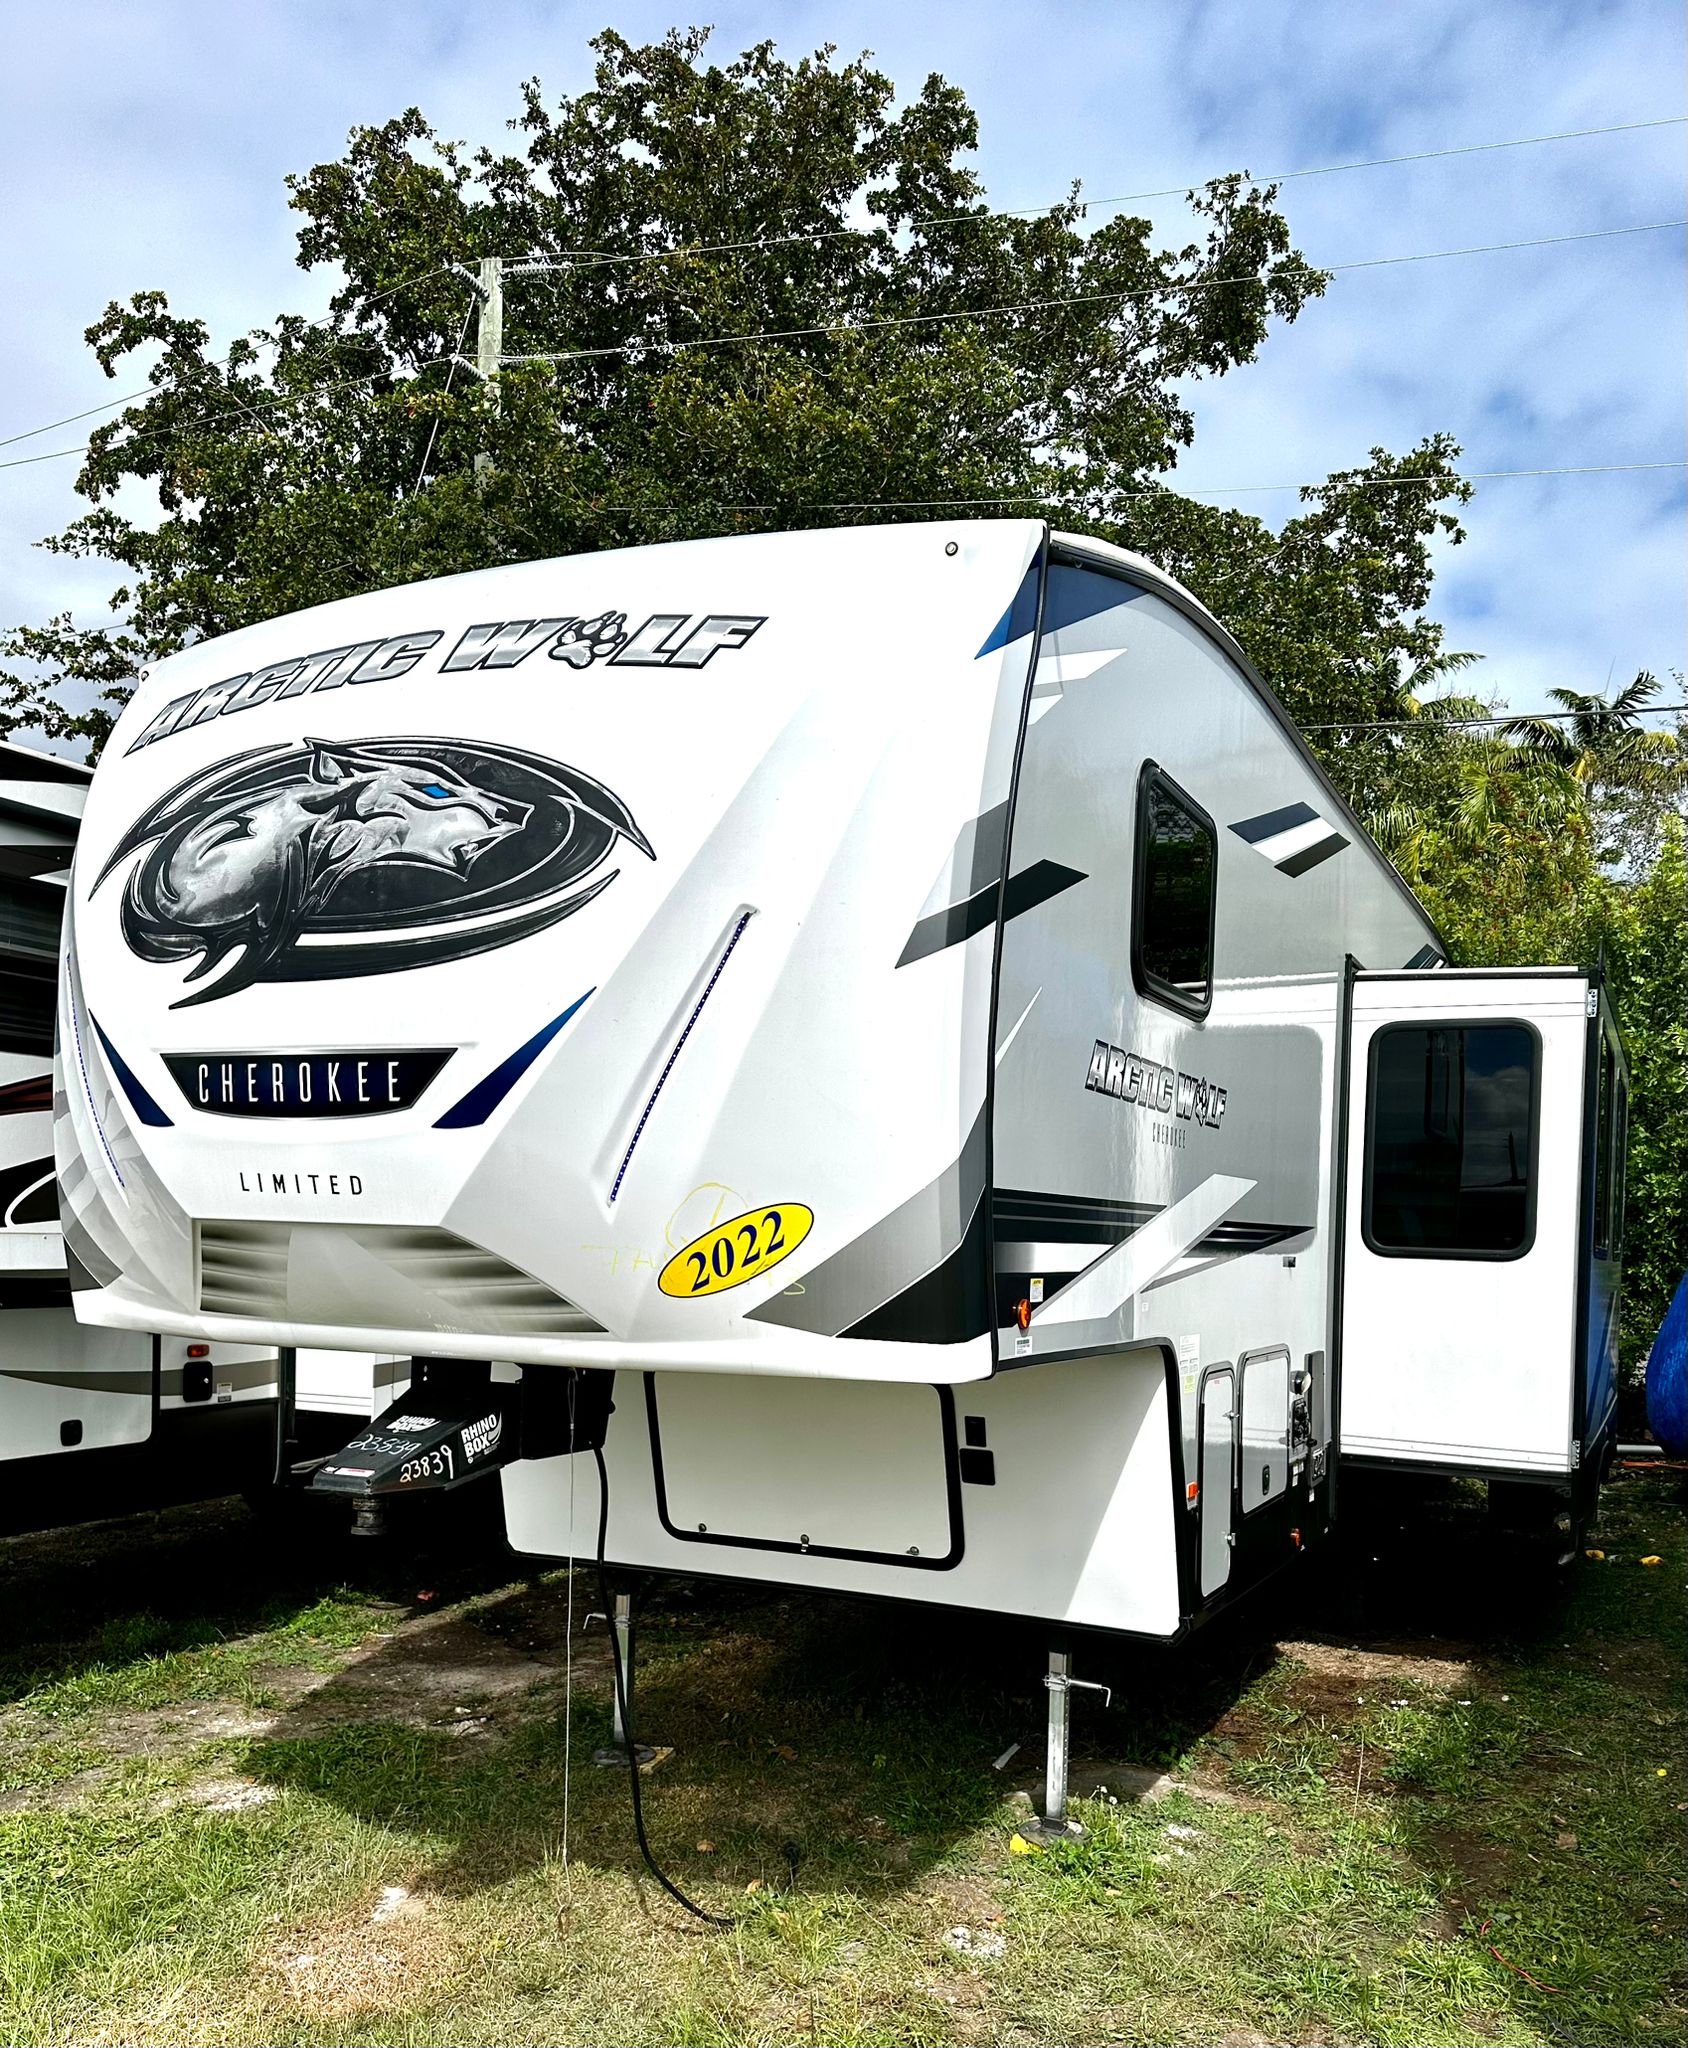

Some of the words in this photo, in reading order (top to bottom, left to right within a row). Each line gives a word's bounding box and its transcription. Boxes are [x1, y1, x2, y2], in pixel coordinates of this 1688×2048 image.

[123, 629, 445, 757] ARCTIC
[199, 1061, 401, 1104] CHEROKEE
[1085, 1039, 1175, 1113] ARCTIC
[1152, 1122, 1186, 1149] CHEROKEE
[239, 1171, 363, 1196] LIMITED
[686, 1210, 785, 1292] 2022
[461, 1414, 497, 1443] RHINO
[347, 1433, 422, 1459] 23839
[464, 1433, 491, 1458] BOX
[400, 1444, 454, 1482] 23839
